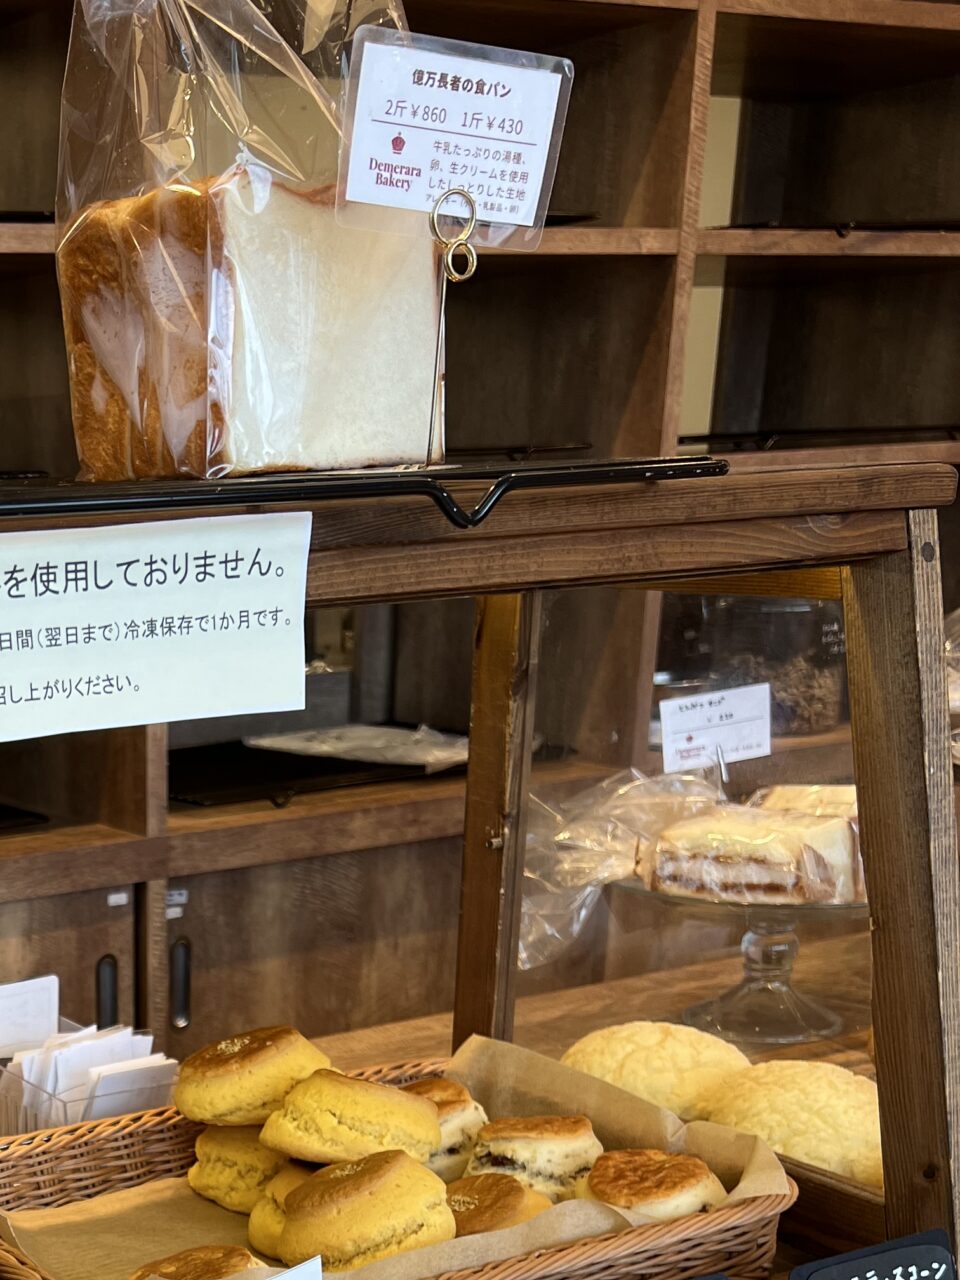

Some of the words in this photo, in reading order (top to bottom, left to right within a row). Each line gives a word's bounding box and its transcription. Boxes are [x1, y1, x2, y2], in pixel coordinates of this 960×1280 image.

[412, 68, 511, 98] 億万長者の食パン
[433, 140, 527, 165] 牛乳たっぷりの湯種、
[369, 157, 422, 177] Demerara
[429, 158, 529, 184] 卵、生クリームを使用
[375, 173, 413, 191] Bakery
